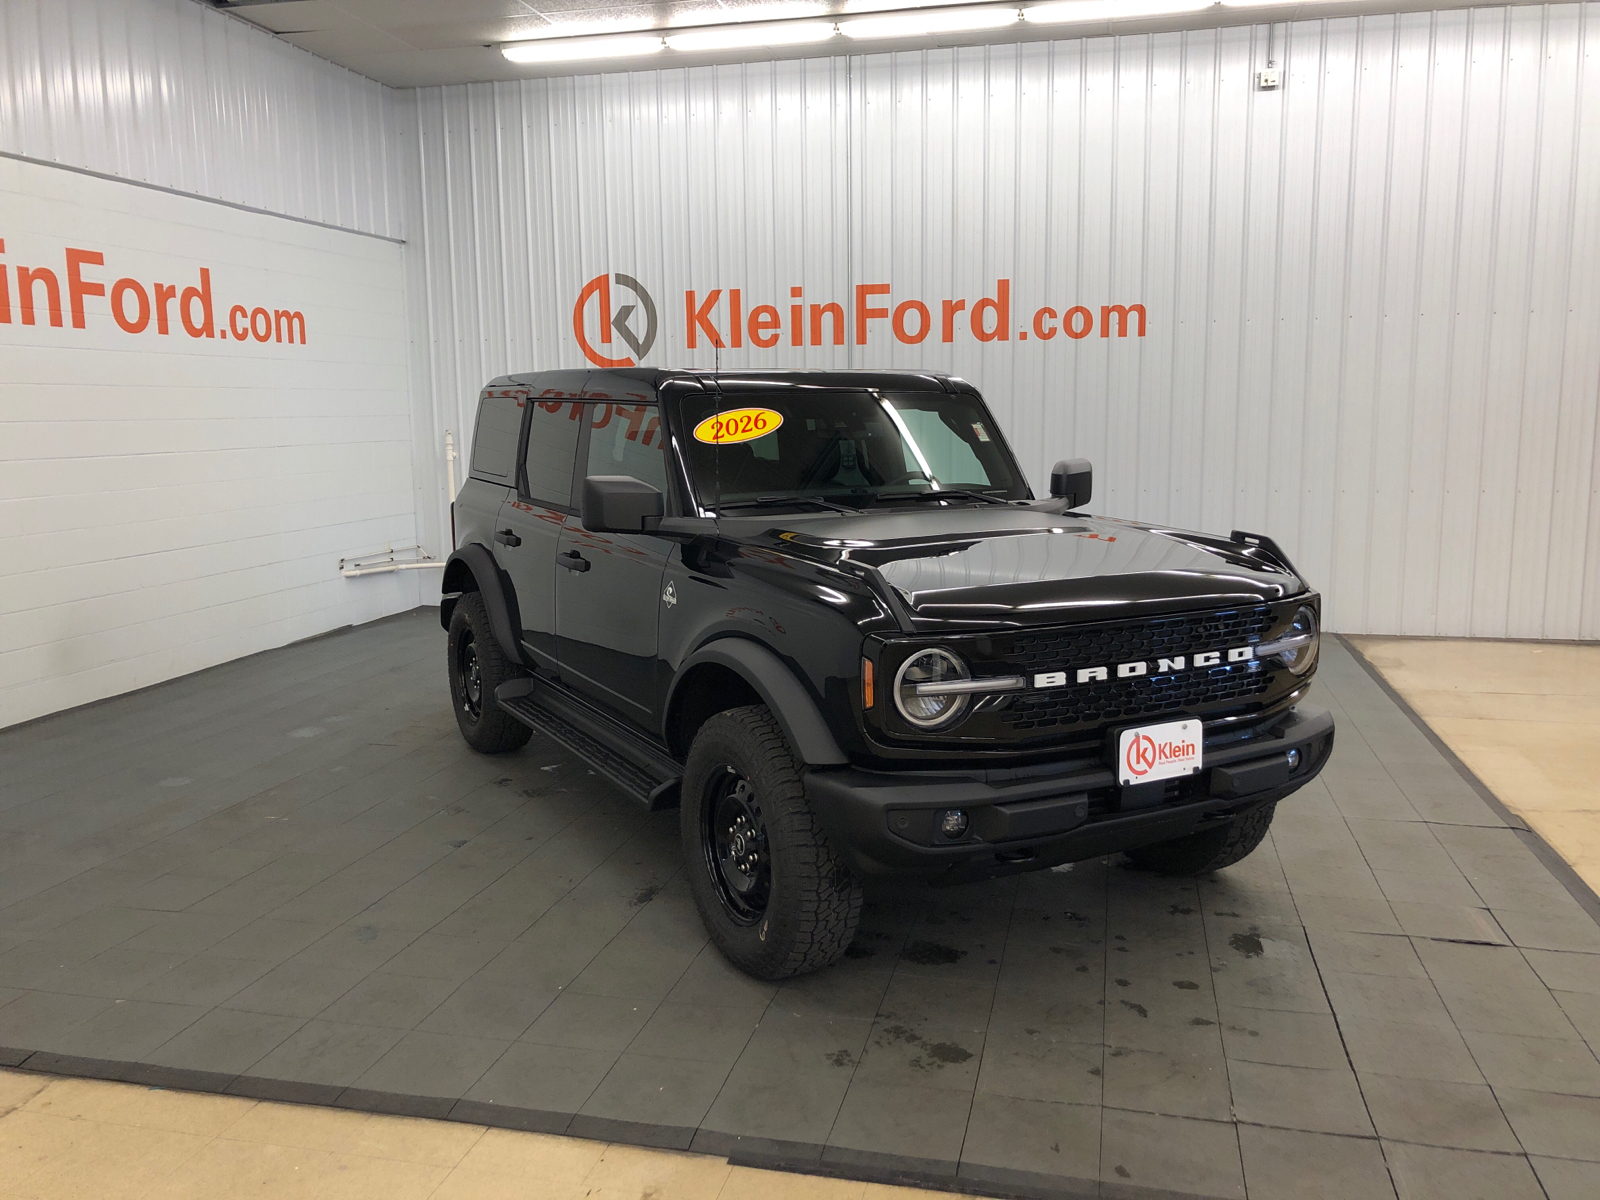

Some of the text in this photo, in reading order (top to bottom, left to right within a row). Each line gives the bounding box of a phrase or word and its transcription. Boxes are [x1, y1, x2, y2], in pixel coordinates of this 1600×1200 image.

[685, 278, 1147, 349] KleinFord.com
[710, 411, 768, 441] 2026
[1033, 646, 1254, 689] BRONCO
[1158, 739, 1196, 761] Klein
